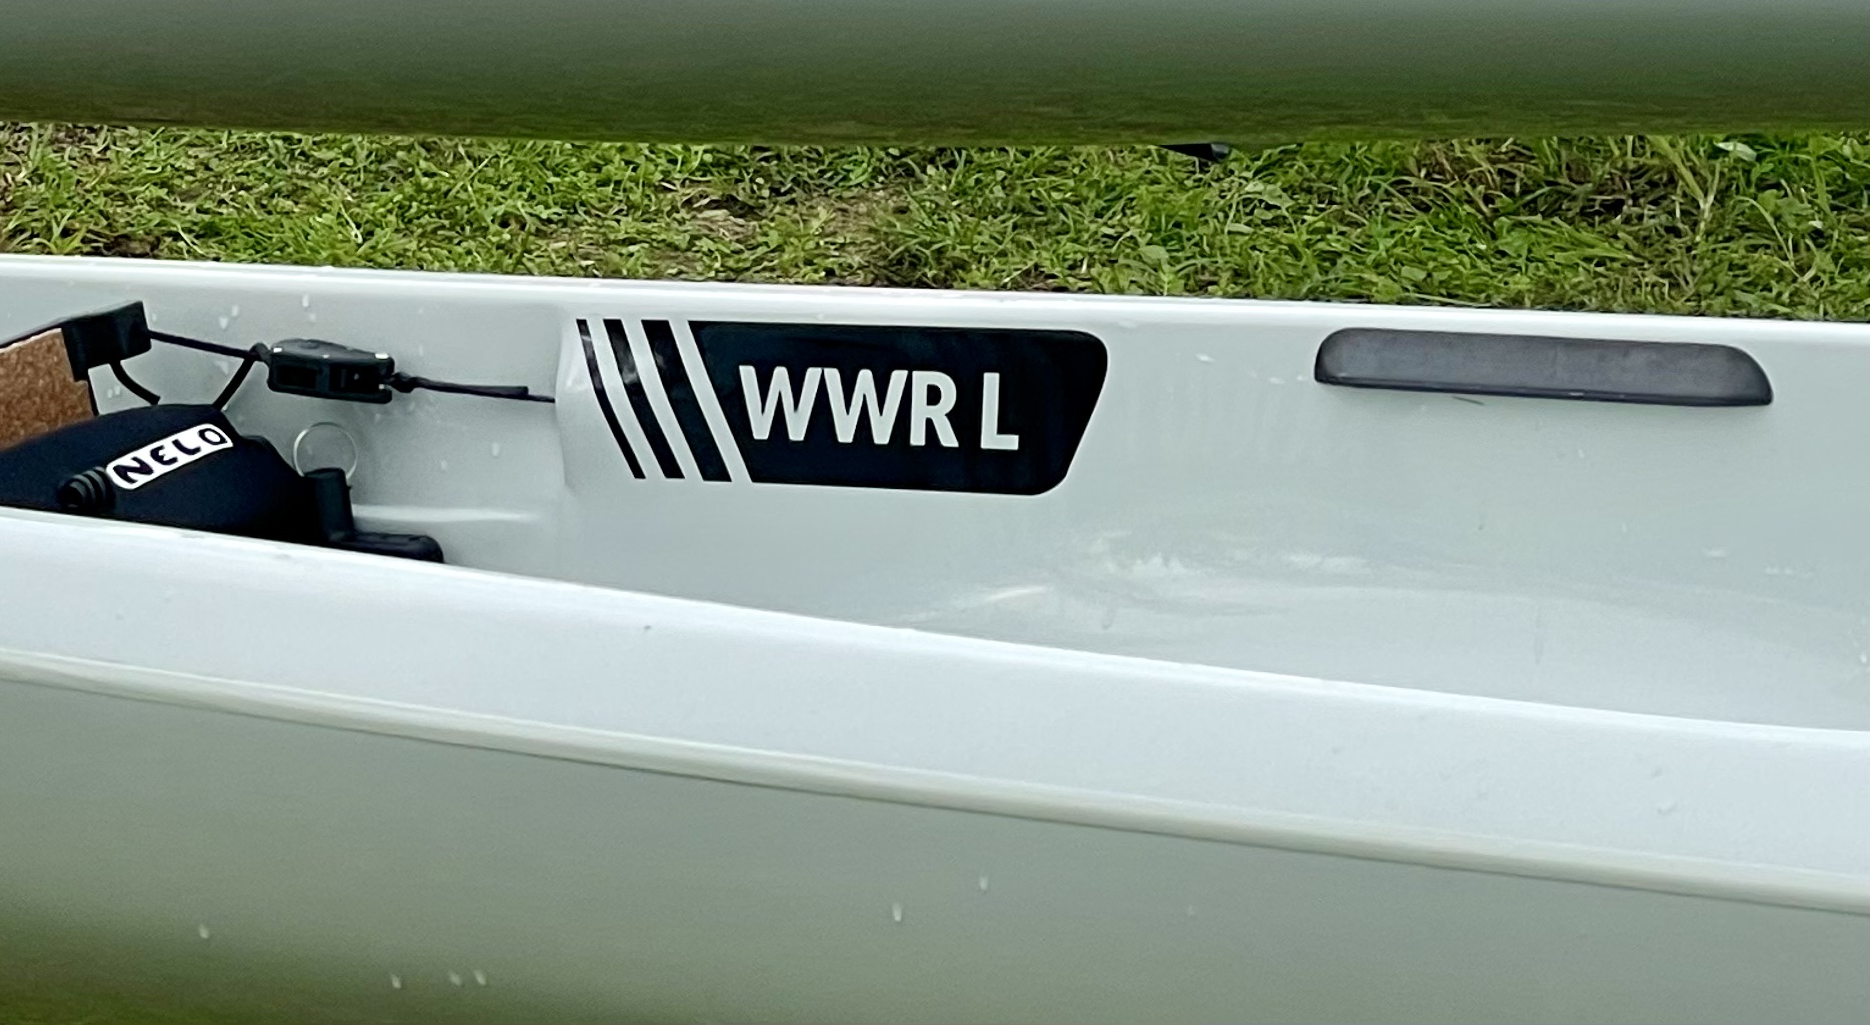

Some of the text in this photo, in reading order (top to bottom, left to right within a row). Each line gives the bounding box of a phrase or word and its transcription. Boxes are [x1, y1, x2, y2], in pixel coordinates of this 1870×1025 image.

[739, 364, 1020, 451] WWR L
[112, 427, 228, 484] NELO
